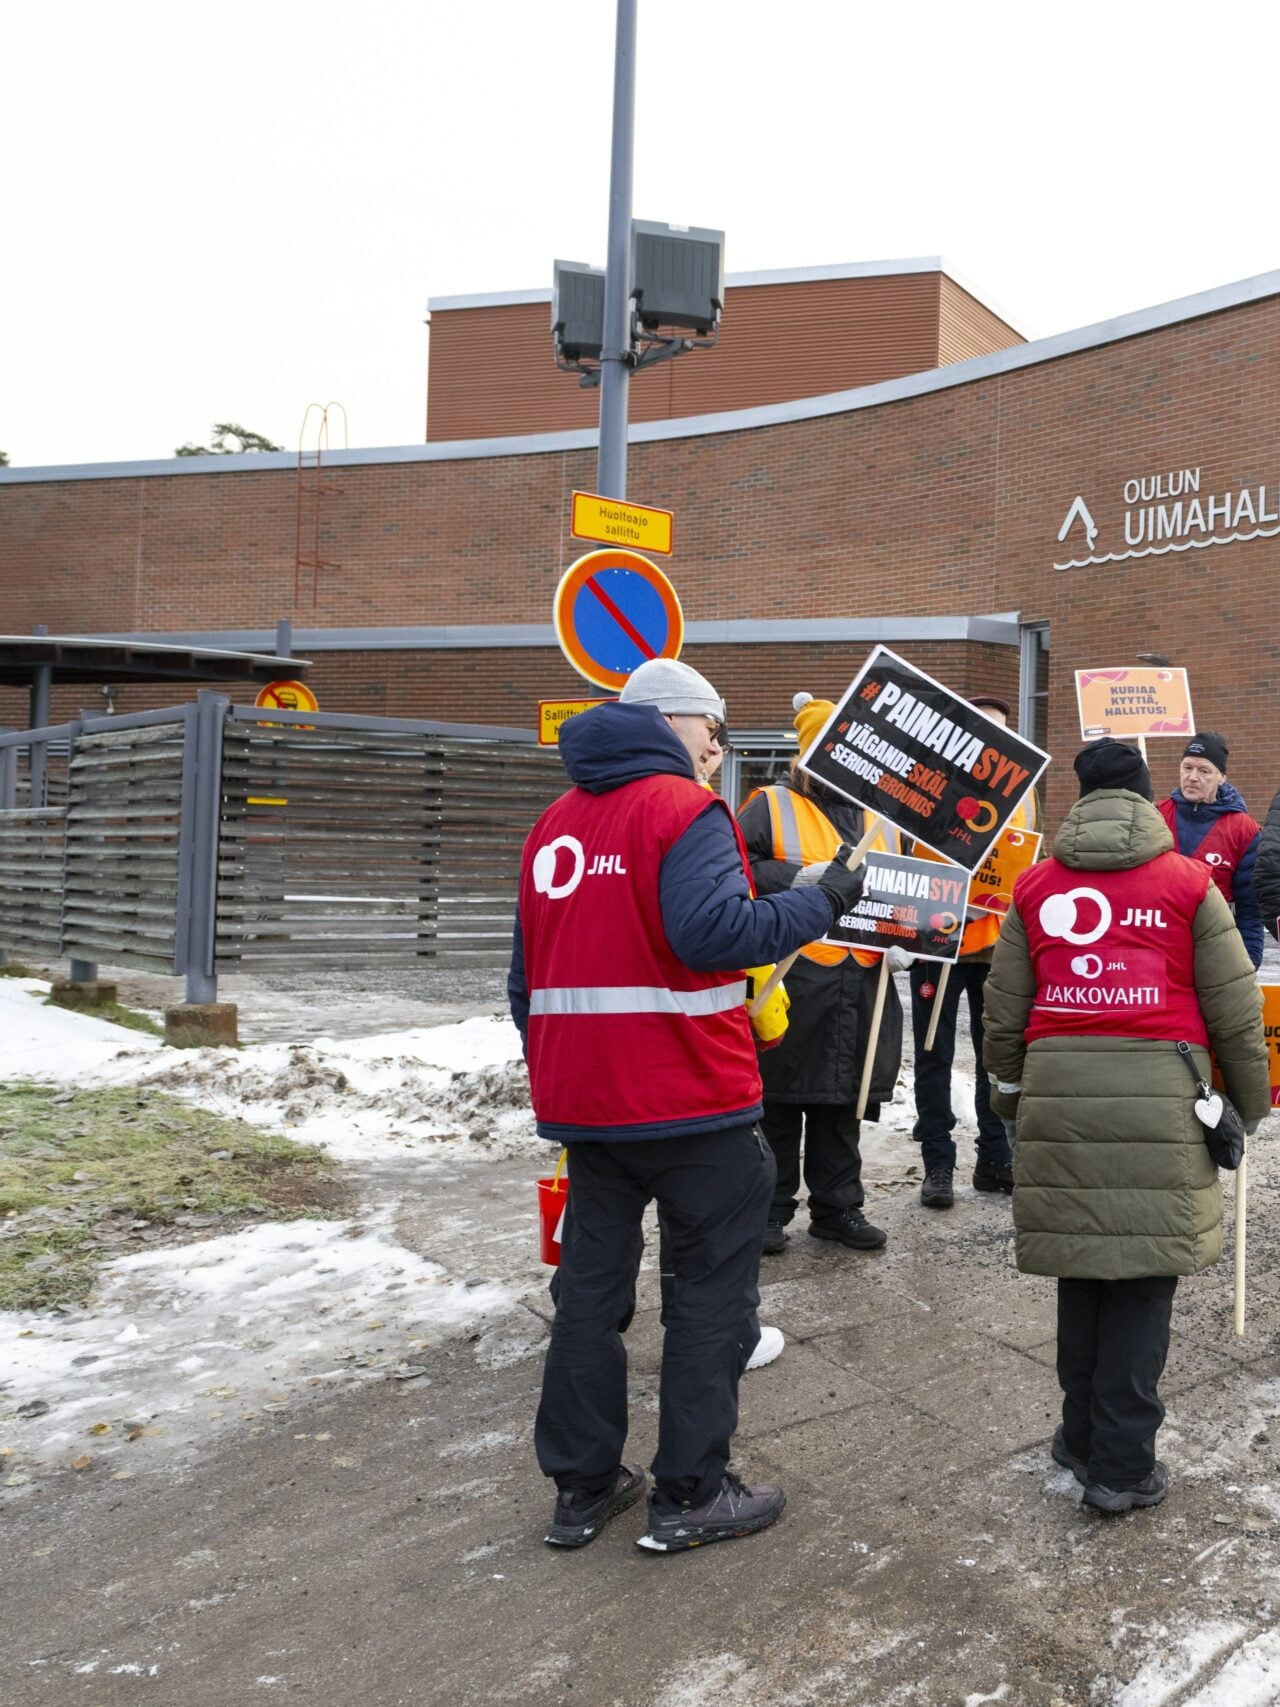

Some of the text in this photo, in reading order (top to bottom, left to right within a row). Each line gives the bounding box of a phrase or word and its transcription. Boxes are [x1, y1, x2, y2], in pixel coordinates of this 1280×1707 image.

[1124, 467, 1200, 504] OULUN
[599, 506, 648, 526] Huoltoajo
[605, 525, 640, 540] sallittu
[1110, 686, 1157, 695] KURIAA
[1111, 694, 1159, 706] KYYTIÄ,
[1105, 706, 1168, 717] HALLITUS!
[860, 681, 1030, 798] #PAINAVASYY
[837, 720, 948, 801] #VÄGANDESKÄL
[823, 742, 936, 818] #SERIOUSGROUNDS
[948, 827, 974, 846] JHL
[587, 854, 626, 875] JHL
[862, 865, 964, 905] AINAVASYY
[1120, 908, 1167, 928] JHL
[1106, 962, 1127, 971] JHL
[1046, 984, 1159, 1005] LAKKOVAHTI
